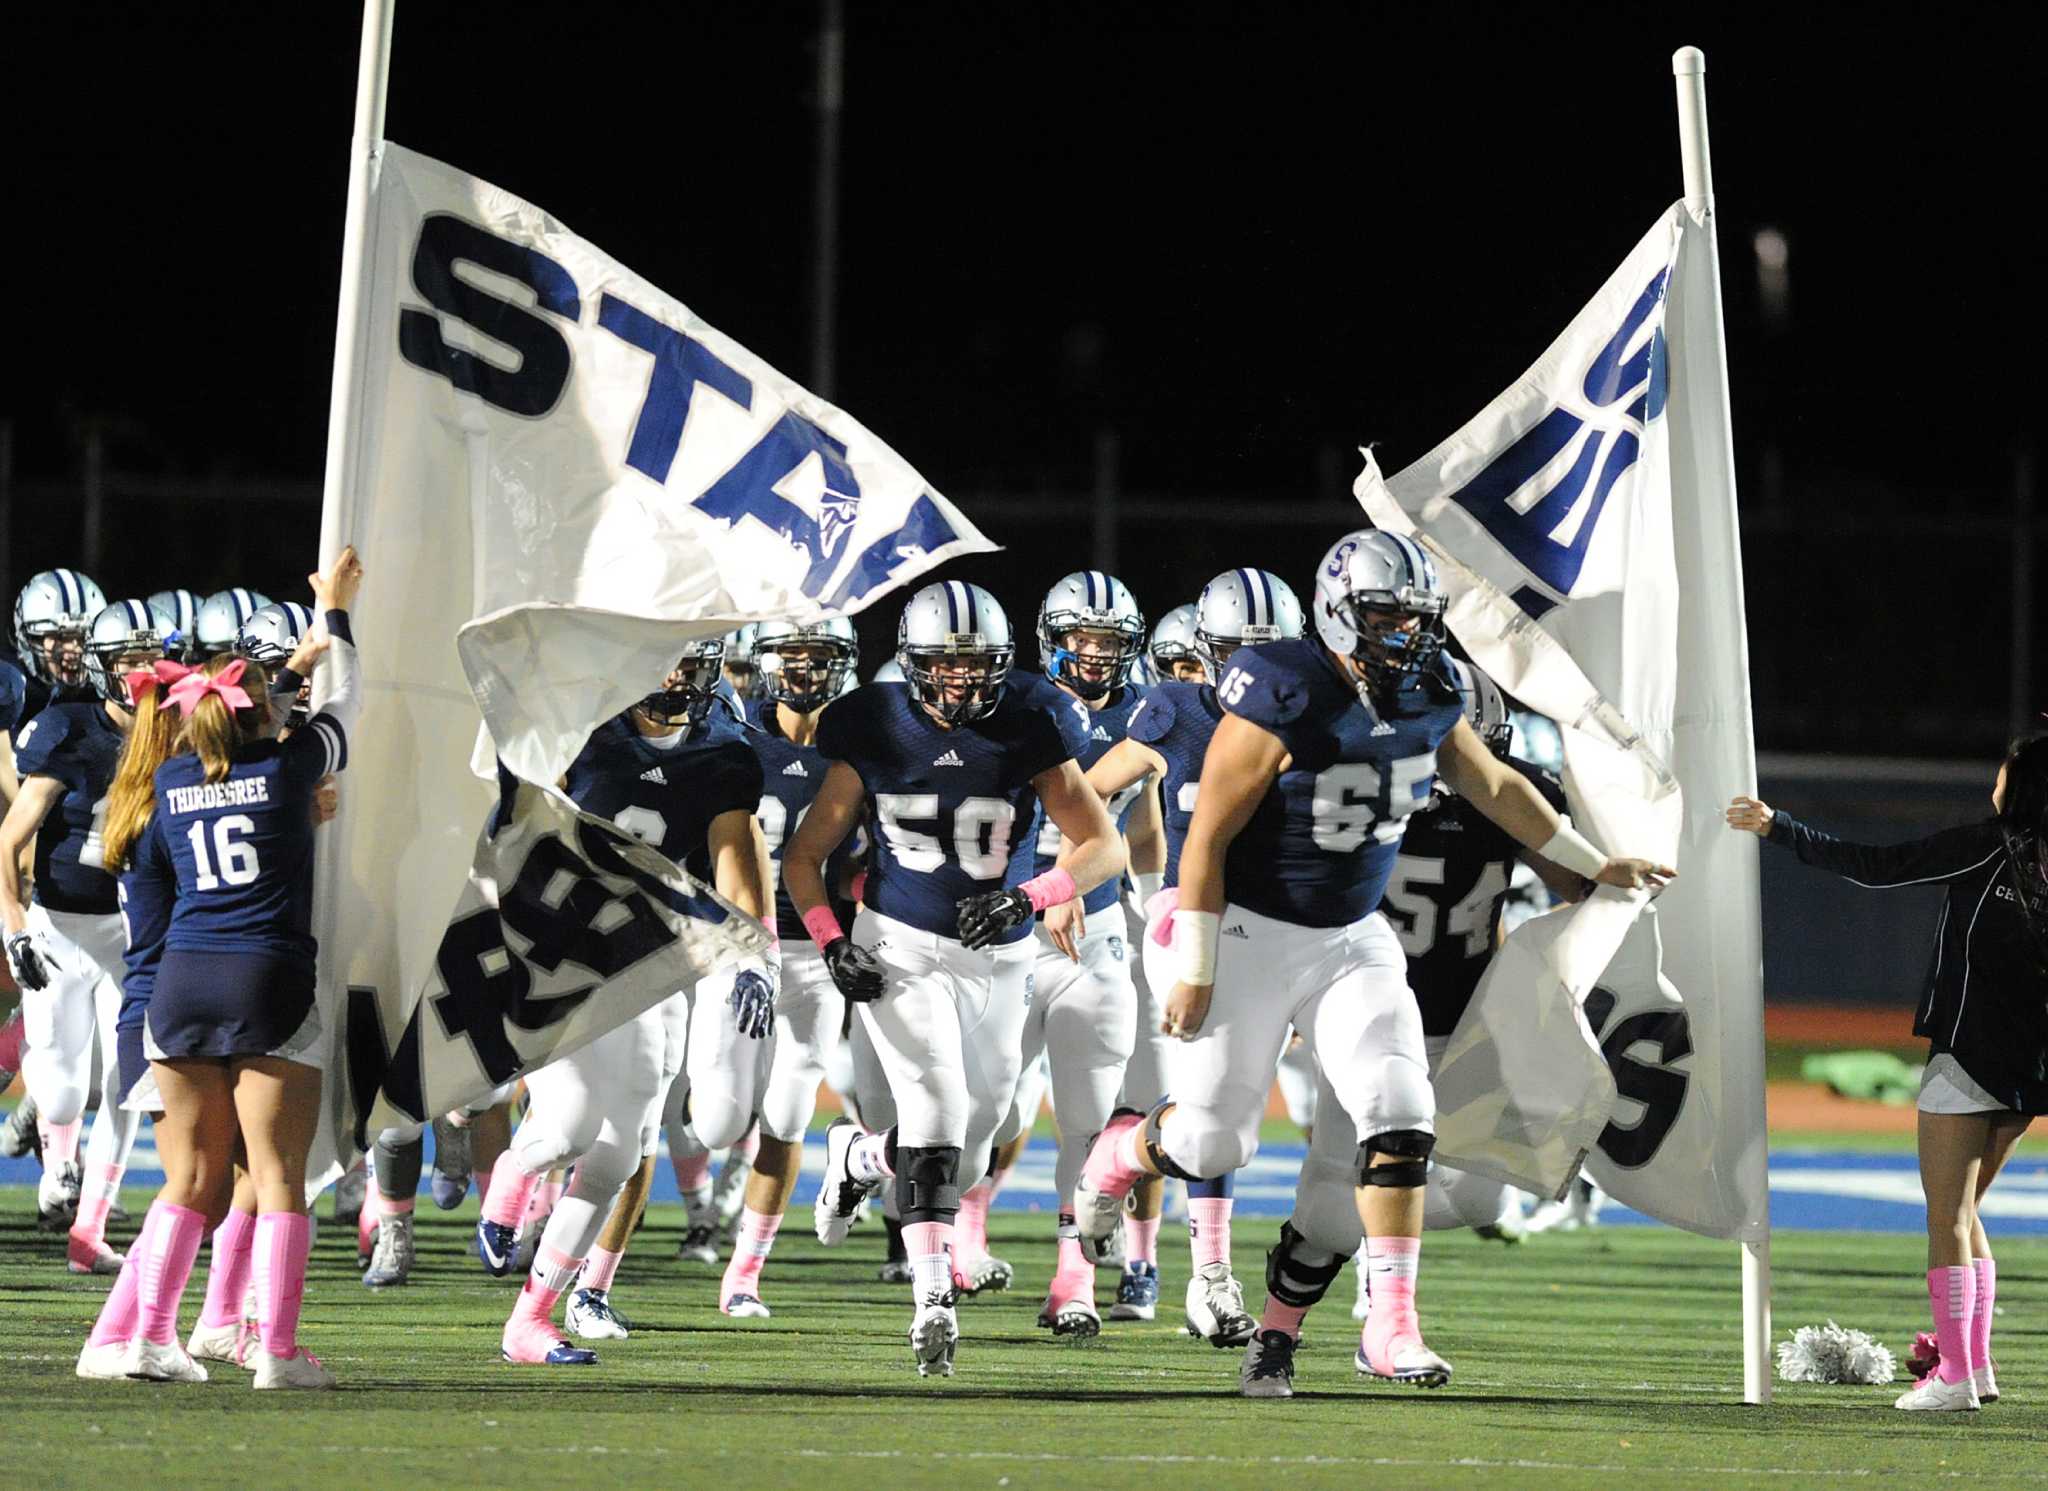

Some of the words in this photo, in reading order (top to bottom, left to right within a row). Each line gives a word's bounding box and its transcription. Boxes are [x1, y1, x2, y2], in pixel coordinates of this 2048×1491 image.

[1219, 666, 1255, 706] 65
[166, 775, 269, 815] THIRDEGREE
[1312, 751, 1437, 852] 65
[187, 814, 261, 891] 16
[875, 793, 1016, 880] 50
[1384, 853, 1506, 959] 54
